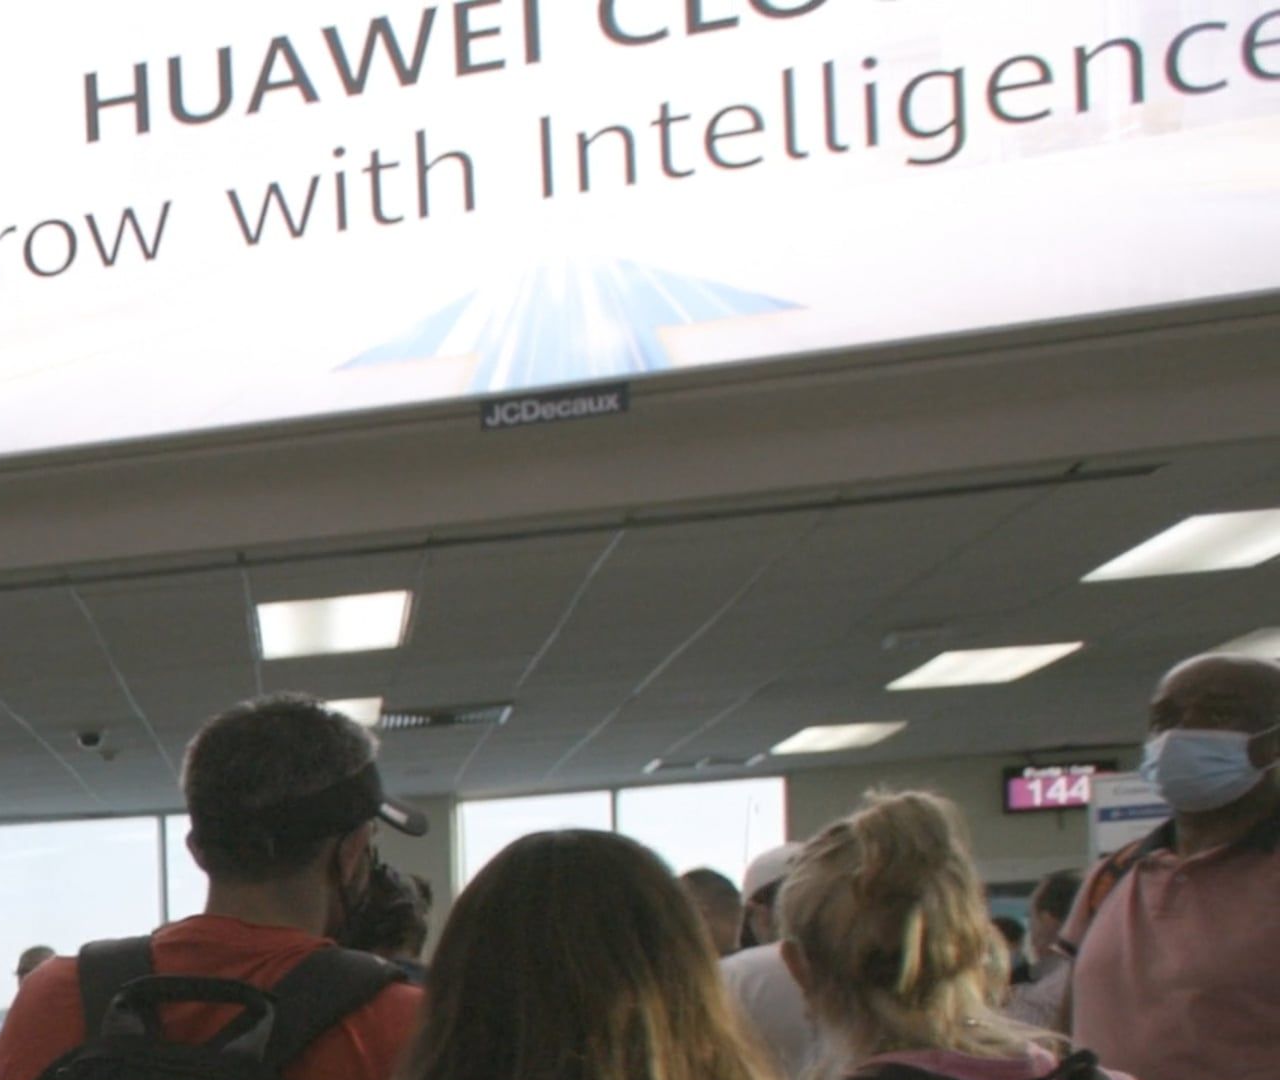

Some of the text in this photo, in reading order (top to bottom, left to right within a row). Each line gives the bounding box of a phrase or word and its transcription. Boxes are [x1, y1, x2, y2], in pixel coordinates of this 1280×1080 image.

[83, 0, 542, 145] HUAWEI
[225, 128, 476, 247] with
[539, 7, 1280, 200] Intelligence
[485, 393, 620, 427] JCDecaux
[1025, 775, 1090, 807] 144
